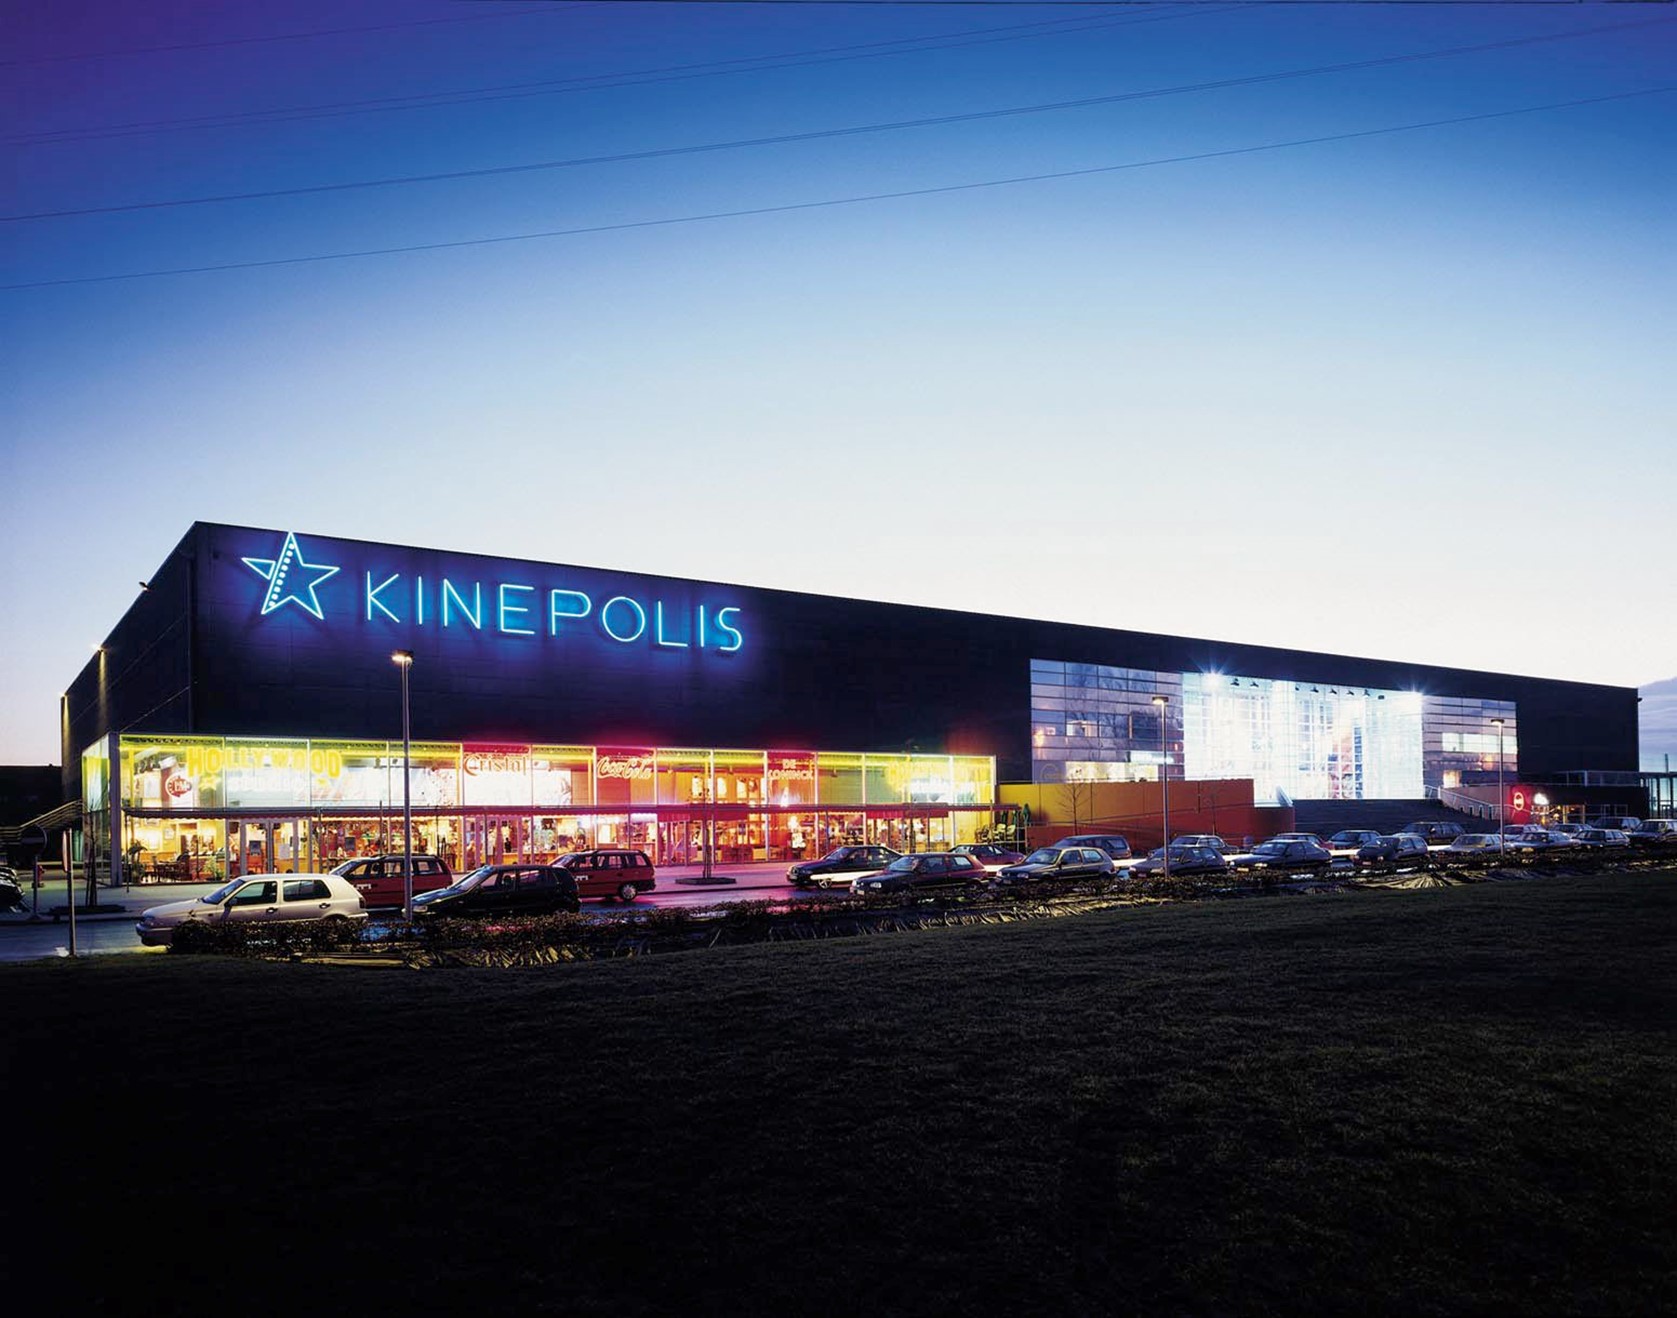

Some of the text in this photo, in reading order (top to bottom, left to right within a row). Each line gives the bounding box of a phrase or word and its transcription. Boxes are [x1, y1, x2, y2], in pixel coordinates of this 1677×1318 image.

[366, 570, 743, 652] KINEPOLIS
[186, 746, 343, 779] HOLLYWOOD
[464, 754, 528, 777] Cristal
[597, 757, 653, 780] Coca-Cola
